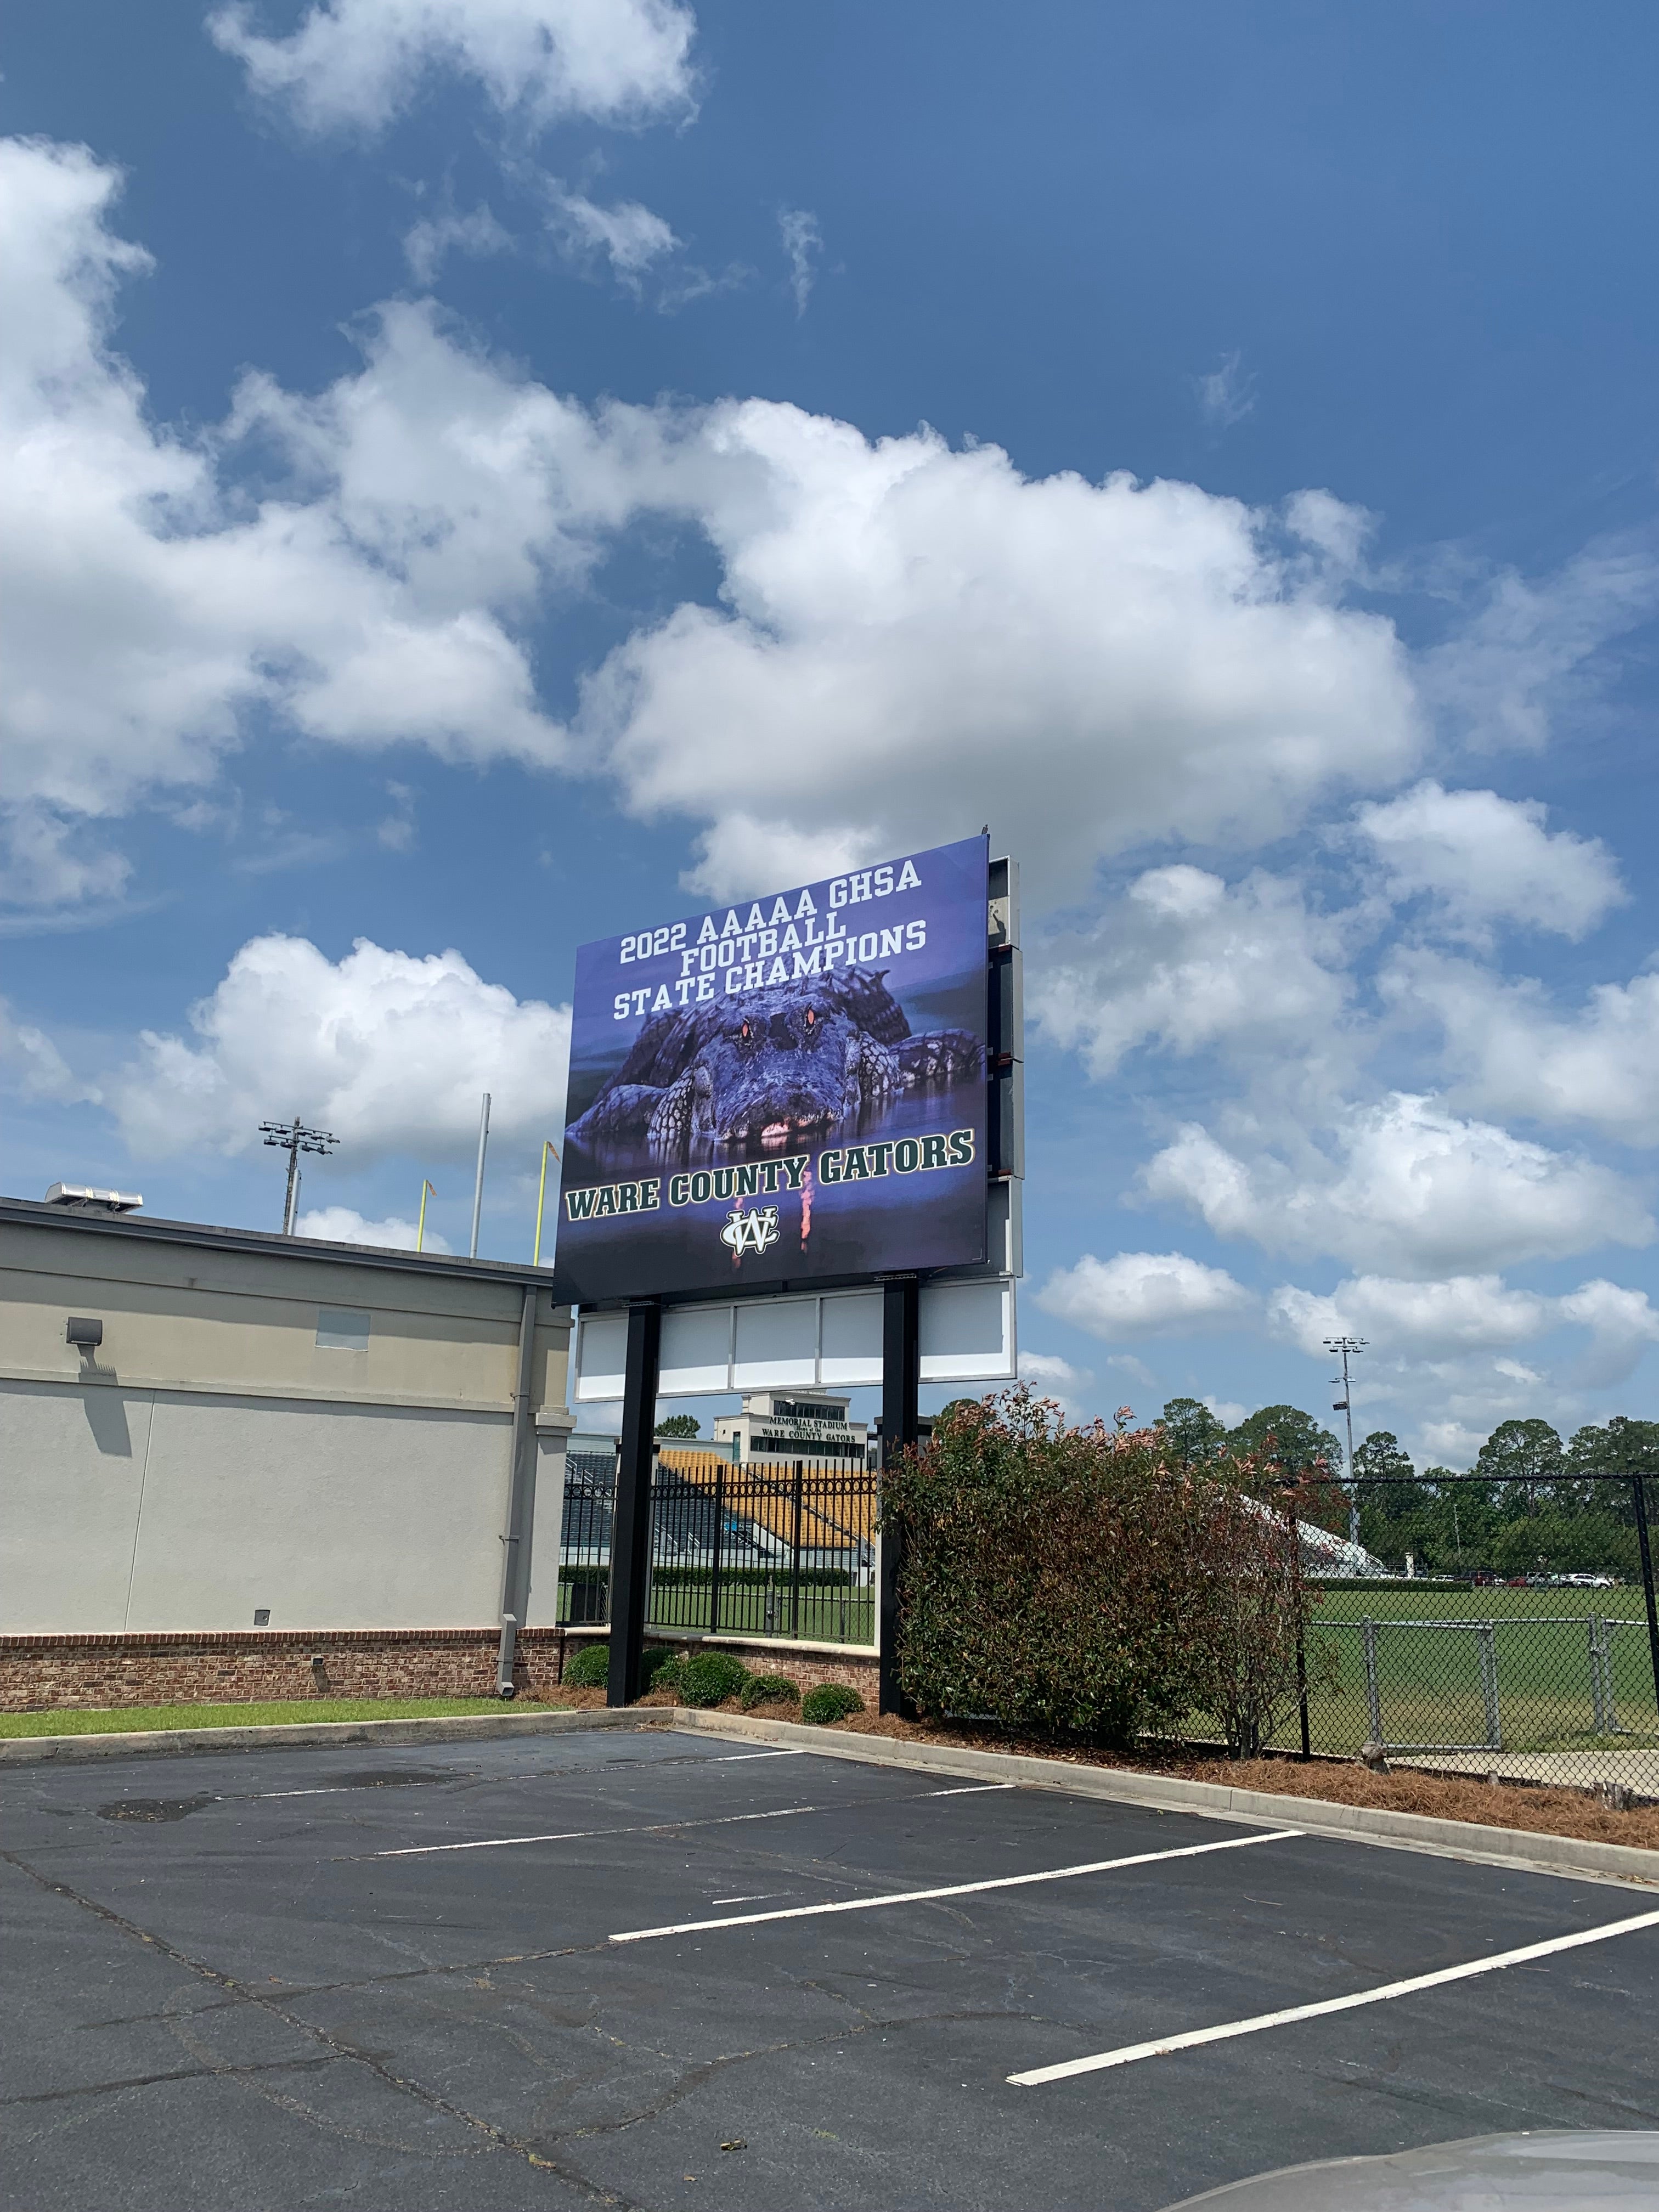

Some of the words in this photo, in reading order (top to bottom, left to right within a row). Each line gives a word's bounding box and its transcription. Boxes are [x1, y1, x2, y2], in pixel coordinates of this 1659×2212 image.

[620, 923, 686, 964] 2022
[697, 889, 817, 944] AAAAA
[829, 860, 922, 909] GHSA
[680, 911, 846, 977] FOOTBALL
[613, 973, 714, 1020] STATE
[725, 919, 927, 995] CHAMPIONS
[566, 1178, 659, 1221] WARE
[670, 1155, 809, 1207] COUNTY
[819, 1128, 975, 1186] GATORS
[762, 1428, 785, 1437] WARE
[789, 1430, 822, 1440] COUNTY
[826, 1433, 855, 1443] GATORS
[770, 1417, 812, 1427] MEMORIAL
[814, 1420, 848, 1430] STADIUM
